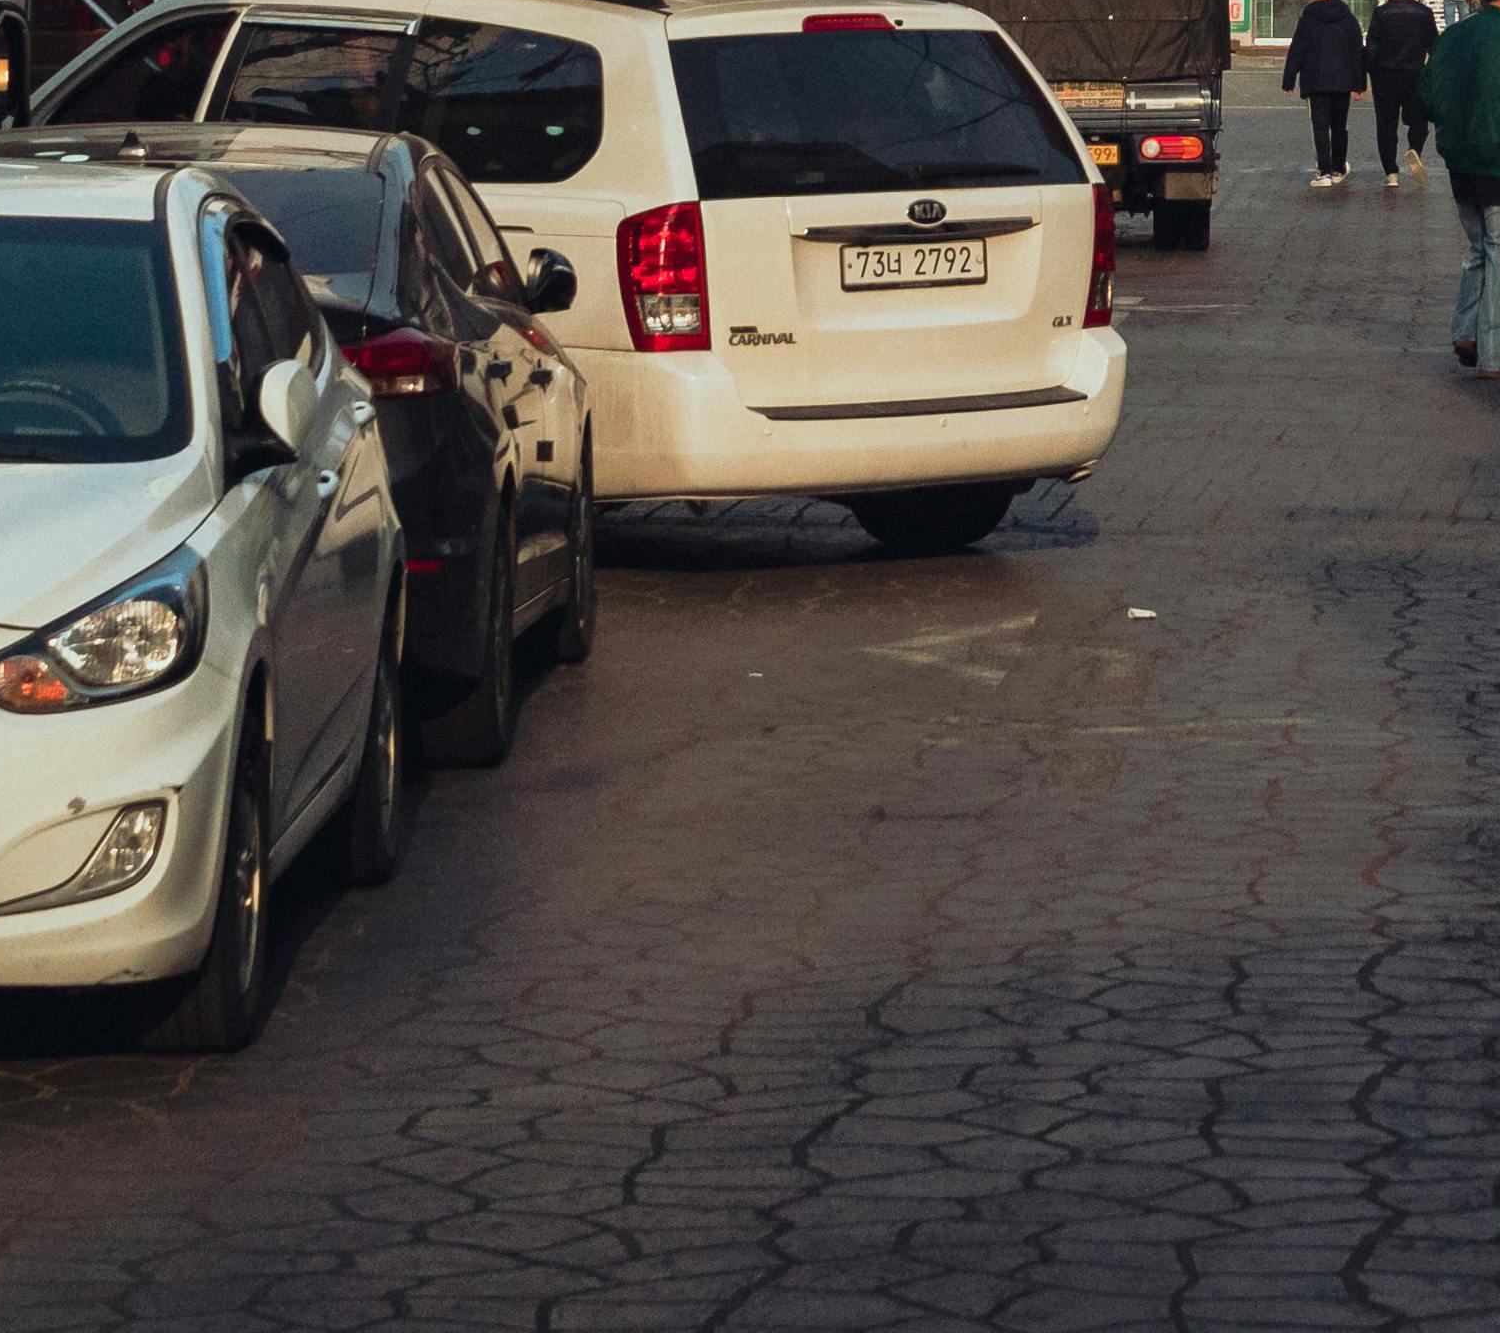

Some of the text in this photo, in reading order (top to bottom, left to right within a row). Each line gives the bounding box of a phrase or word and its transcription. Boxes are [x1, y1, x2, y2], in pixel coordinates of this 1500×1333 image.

[913, 202, 942, 220] KIA
[855, 246, 972, 279] 73너 2792
[1052, 315, 1073, 329] GLX
[728, 332, 797, 347] CARNIVAL
